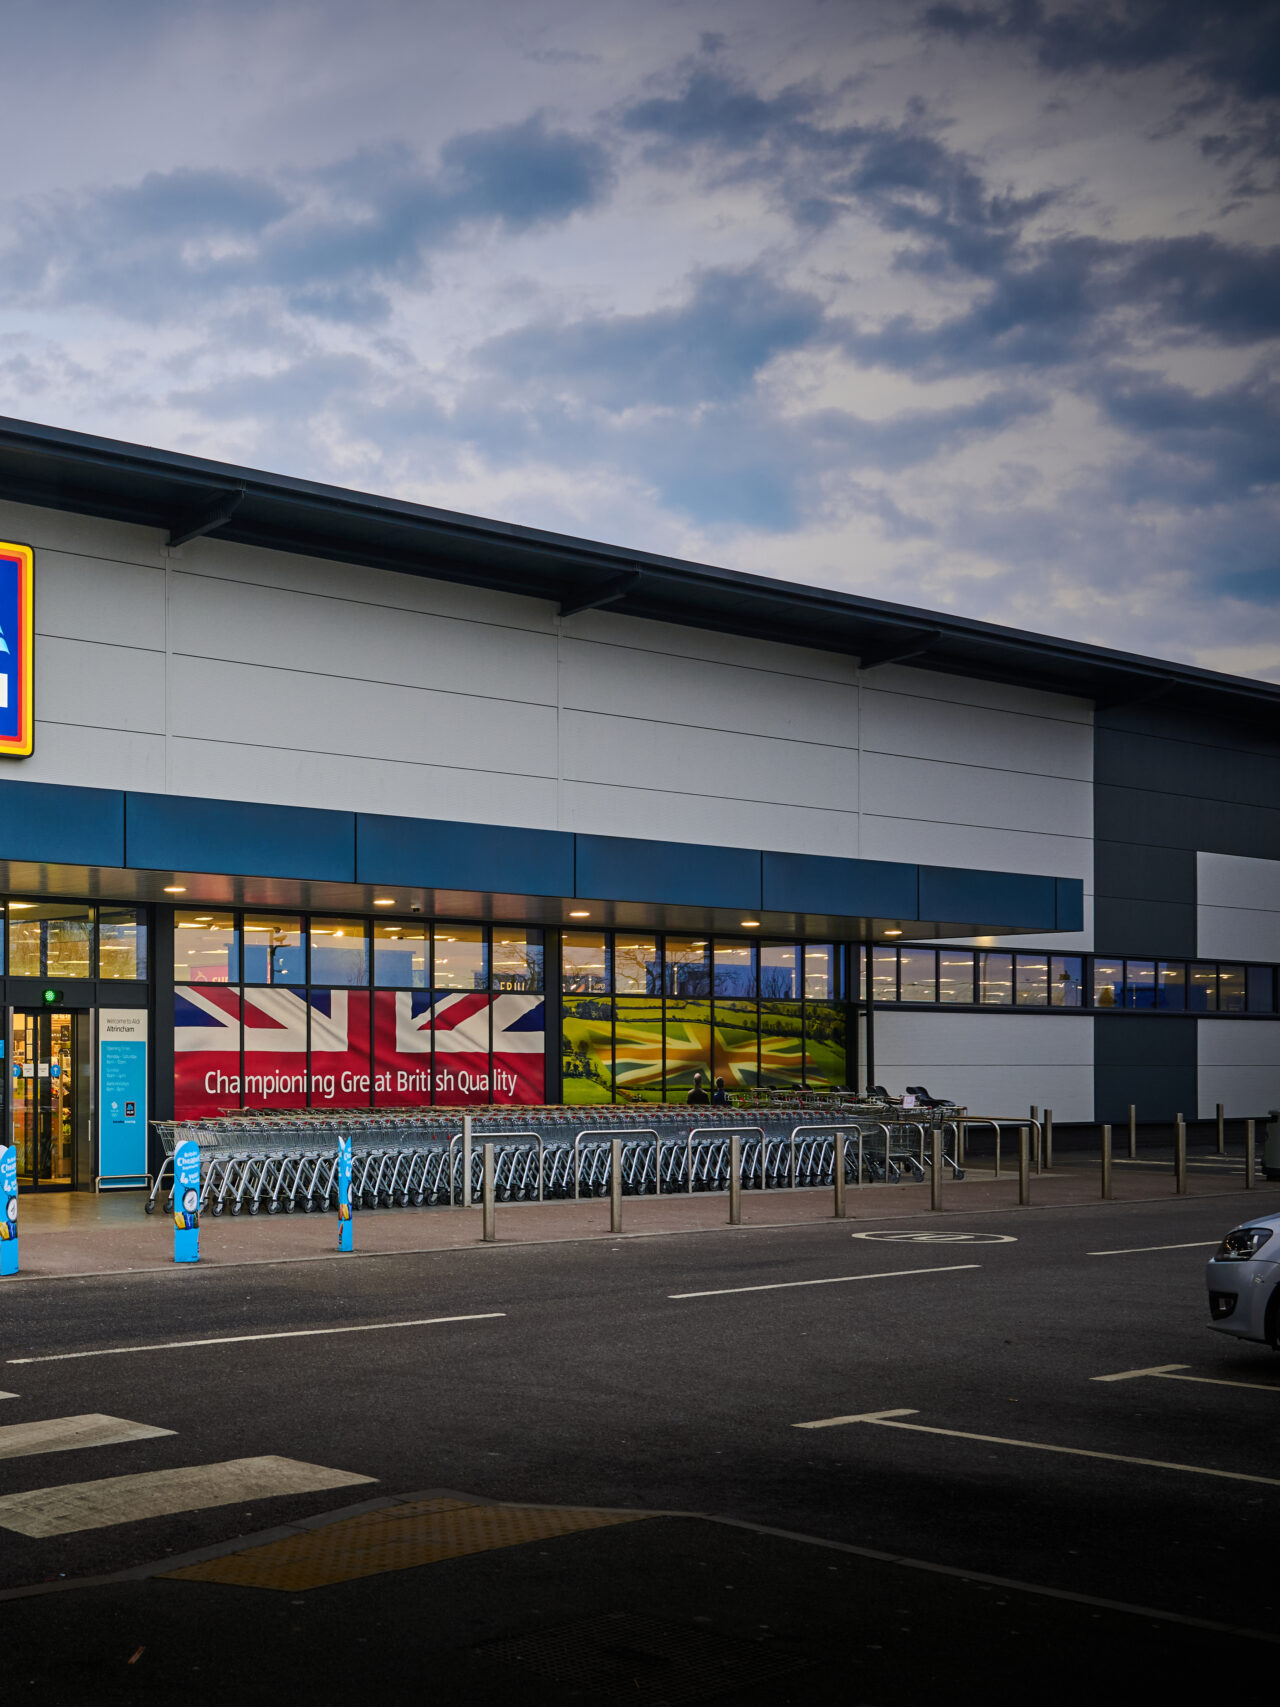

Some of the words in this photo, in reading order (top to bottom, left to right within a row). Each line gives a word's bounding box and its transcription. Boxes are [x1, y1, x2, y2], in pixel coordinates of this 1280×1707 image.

[205, 1069, 335, 1099] Championing
[340, 1071, 392, 1093] Great
[397, 1068, 454, 1092] British
[458, 1068, 517, 1096] Quality
